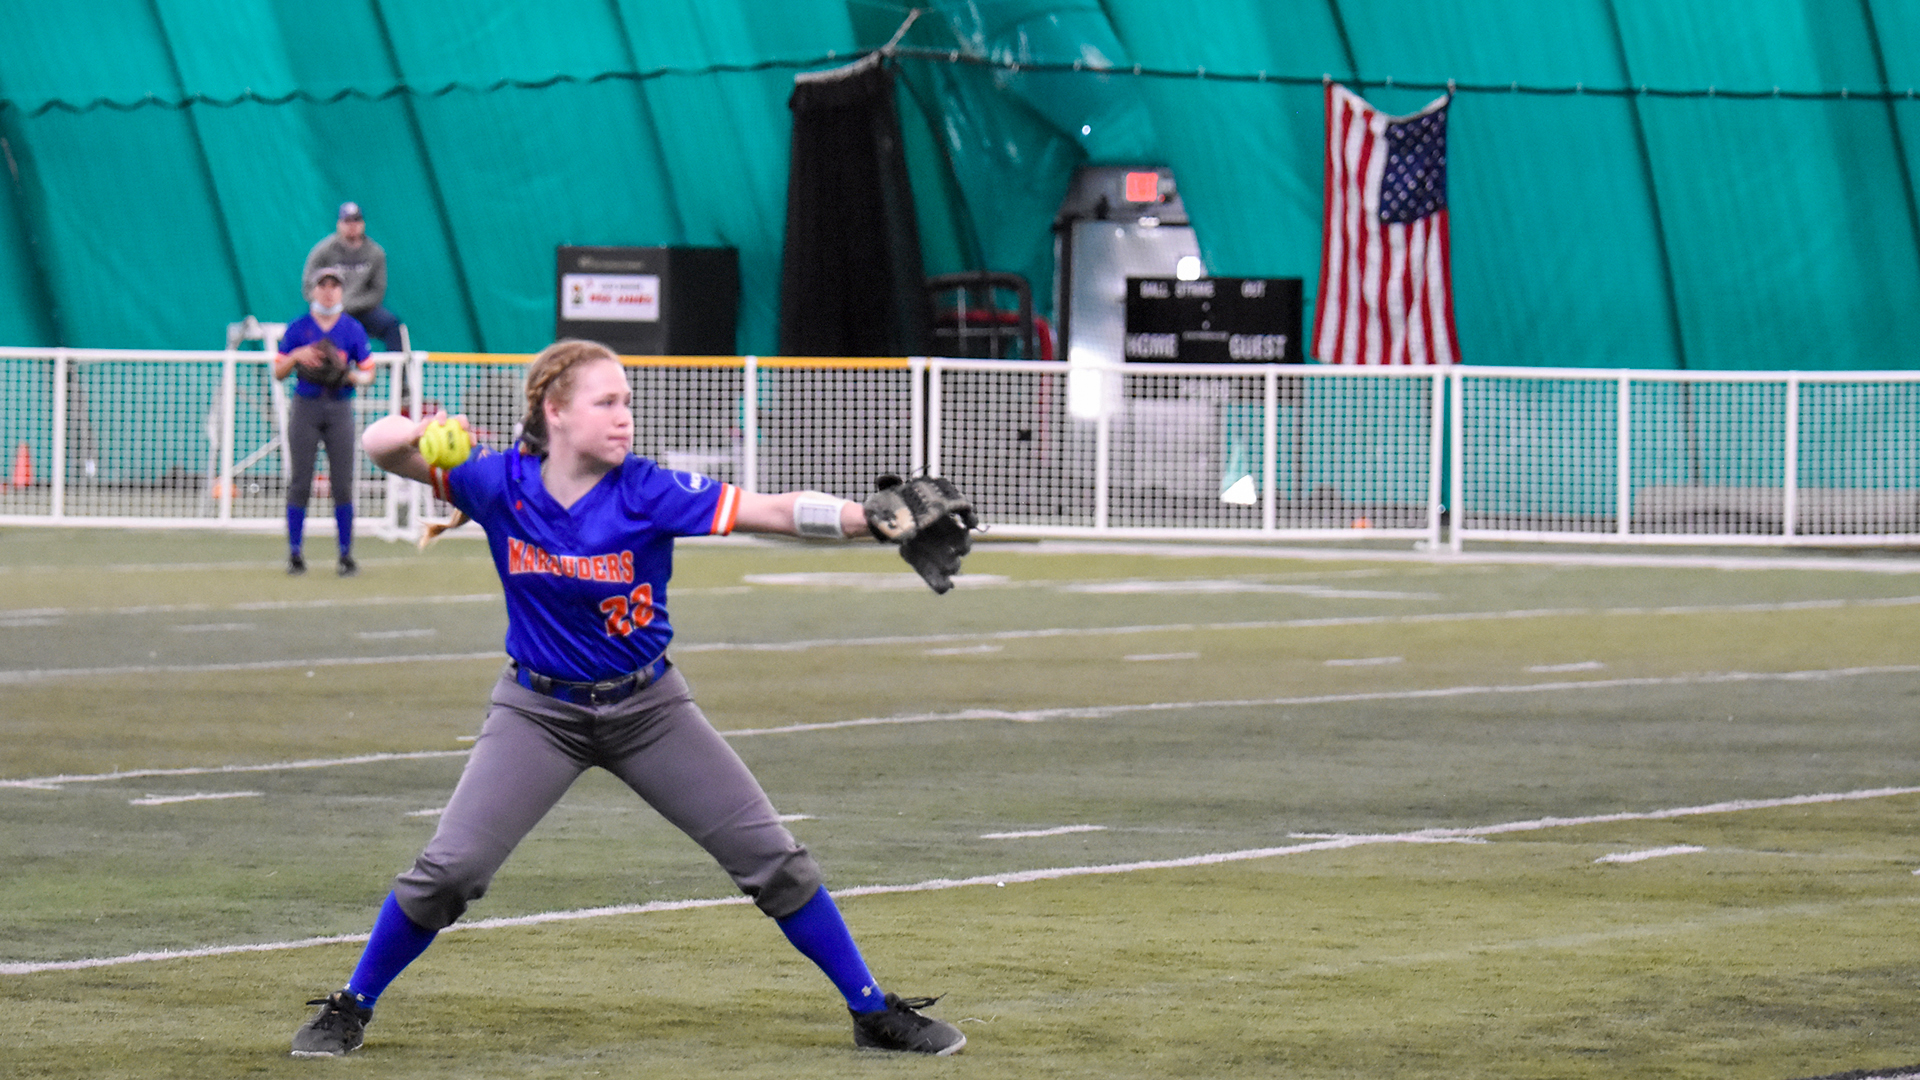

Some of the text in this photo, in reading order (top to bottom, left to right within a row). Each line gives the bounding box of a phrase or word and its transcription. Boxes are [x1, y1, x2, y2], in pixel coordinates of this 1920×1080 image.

[1241, 280, 1266, 298] OUT
[1126, 333, 1179, 359] HOME
[1229, 333, 1287, 360] GUEST
[508, 536, 635, 584] MARAUDERS
